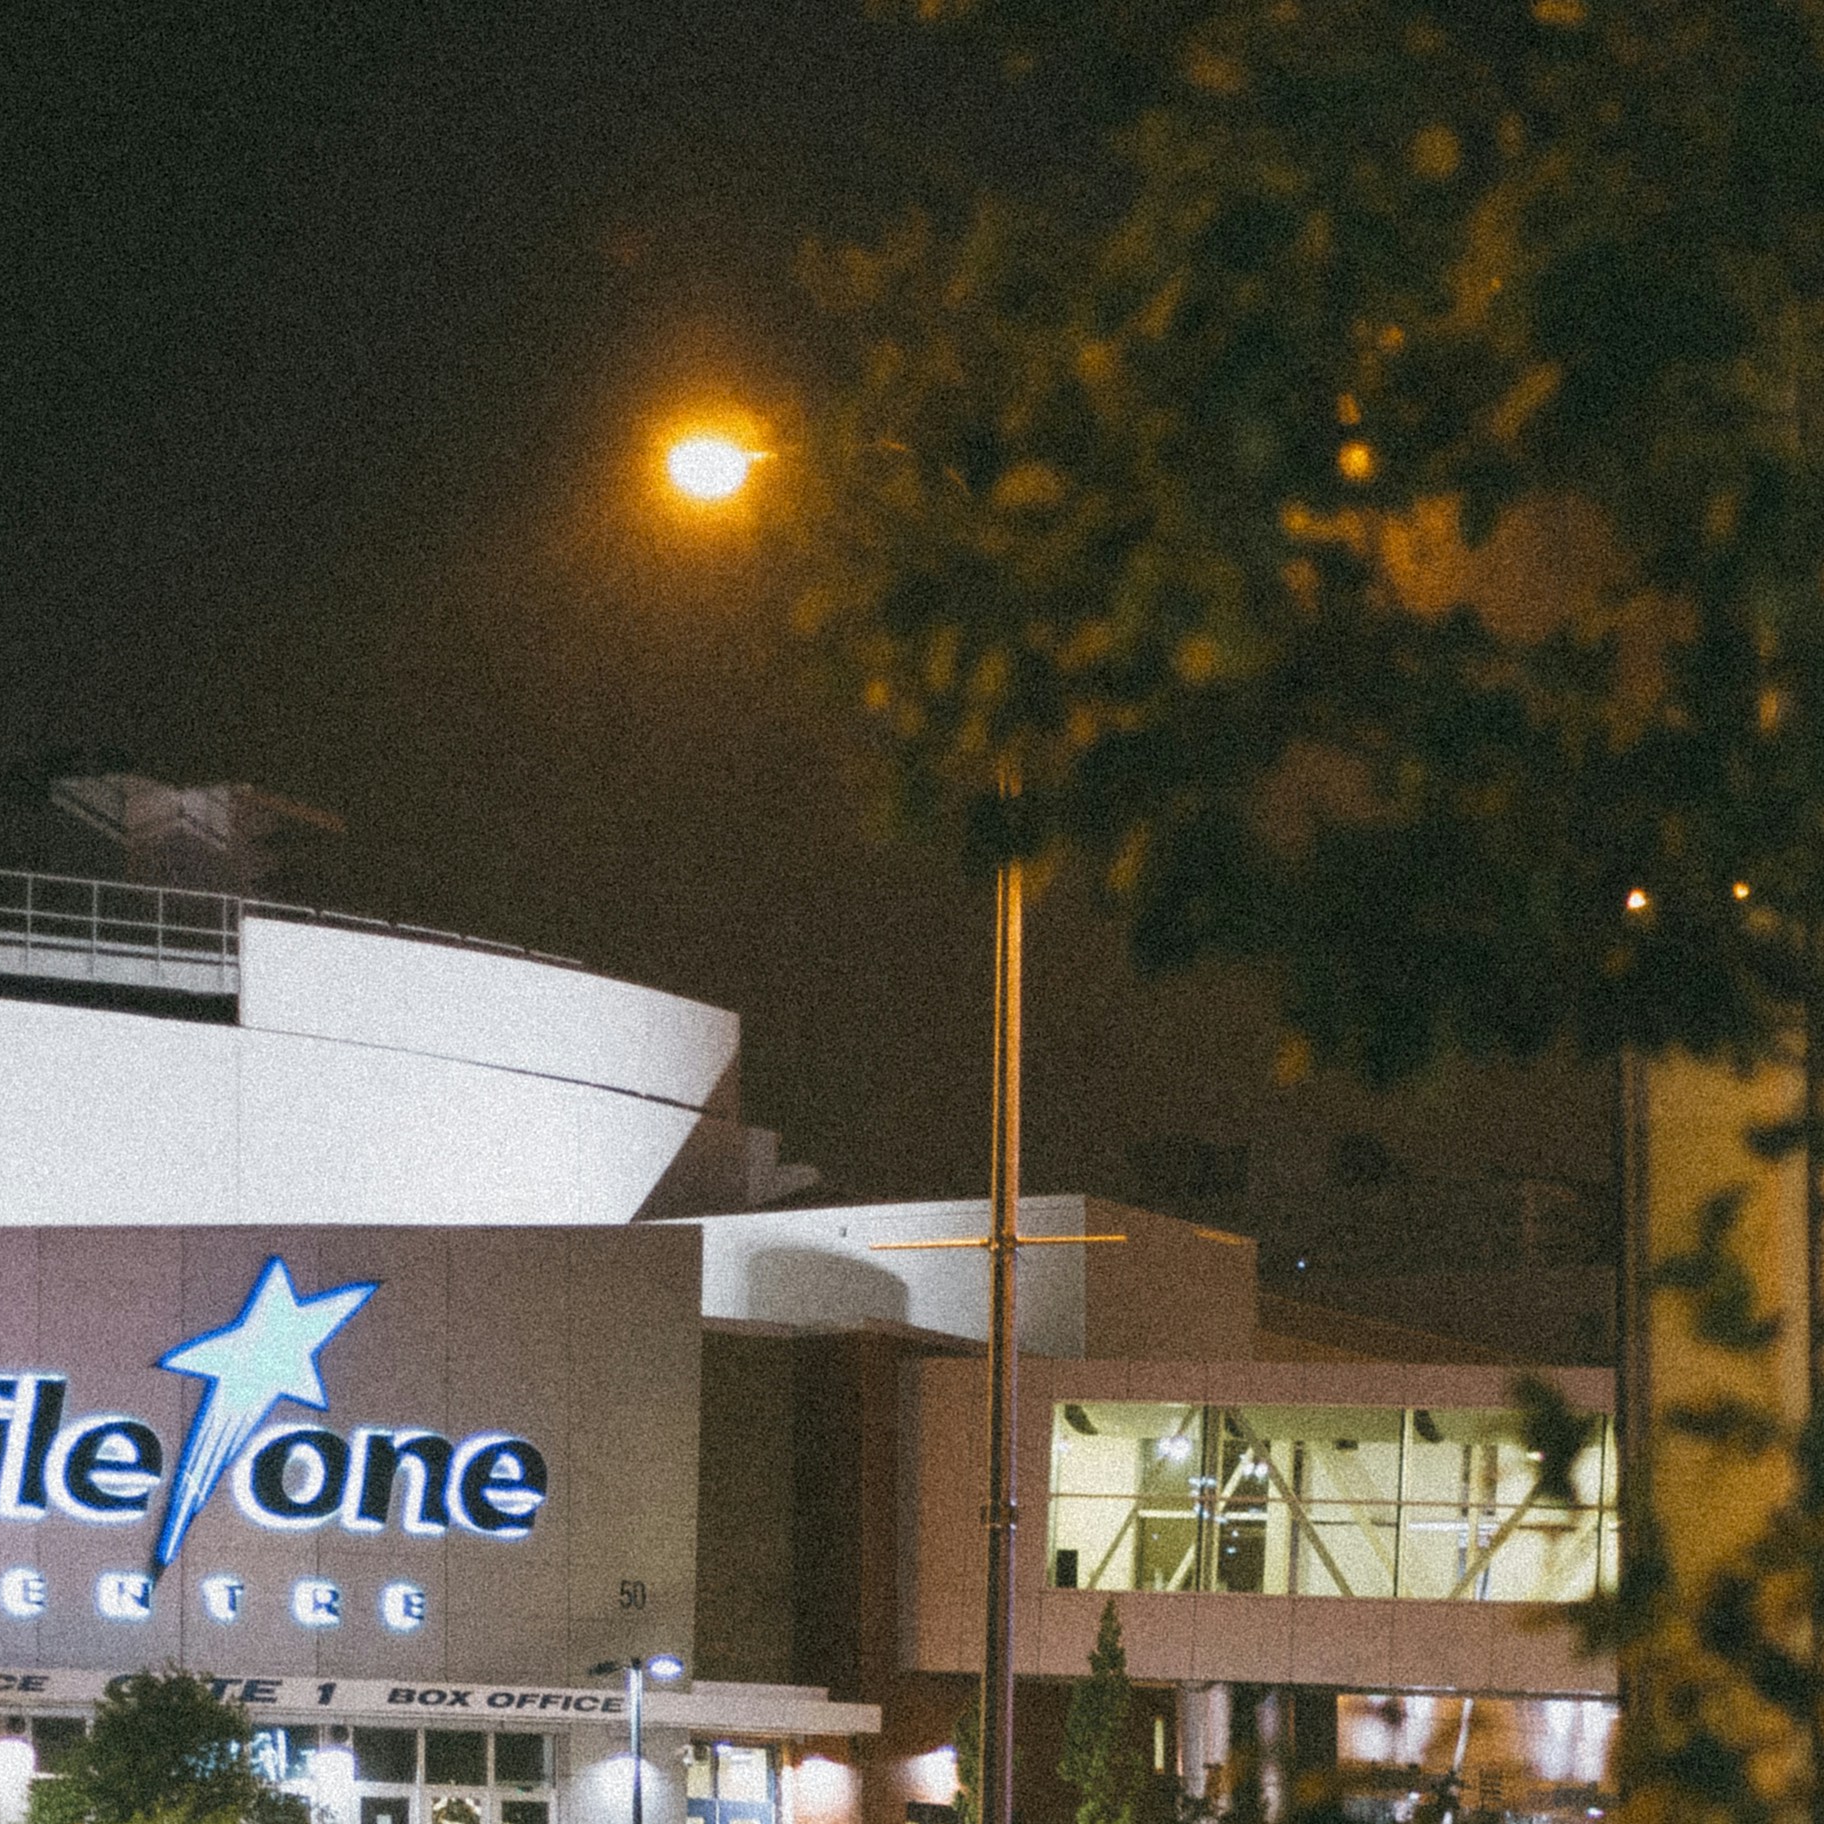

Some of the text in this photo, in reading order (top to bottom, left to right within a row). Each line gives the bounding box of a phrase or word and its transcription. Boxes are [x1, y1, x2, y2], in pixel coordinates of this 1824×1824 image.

[236, 1424, 547, 1537] one
[619, 1579, 647, 1611] 50
[106, 1673, 337, 1706] TE 1
[387, 1687, 625, 1713] BOX OFFICE
